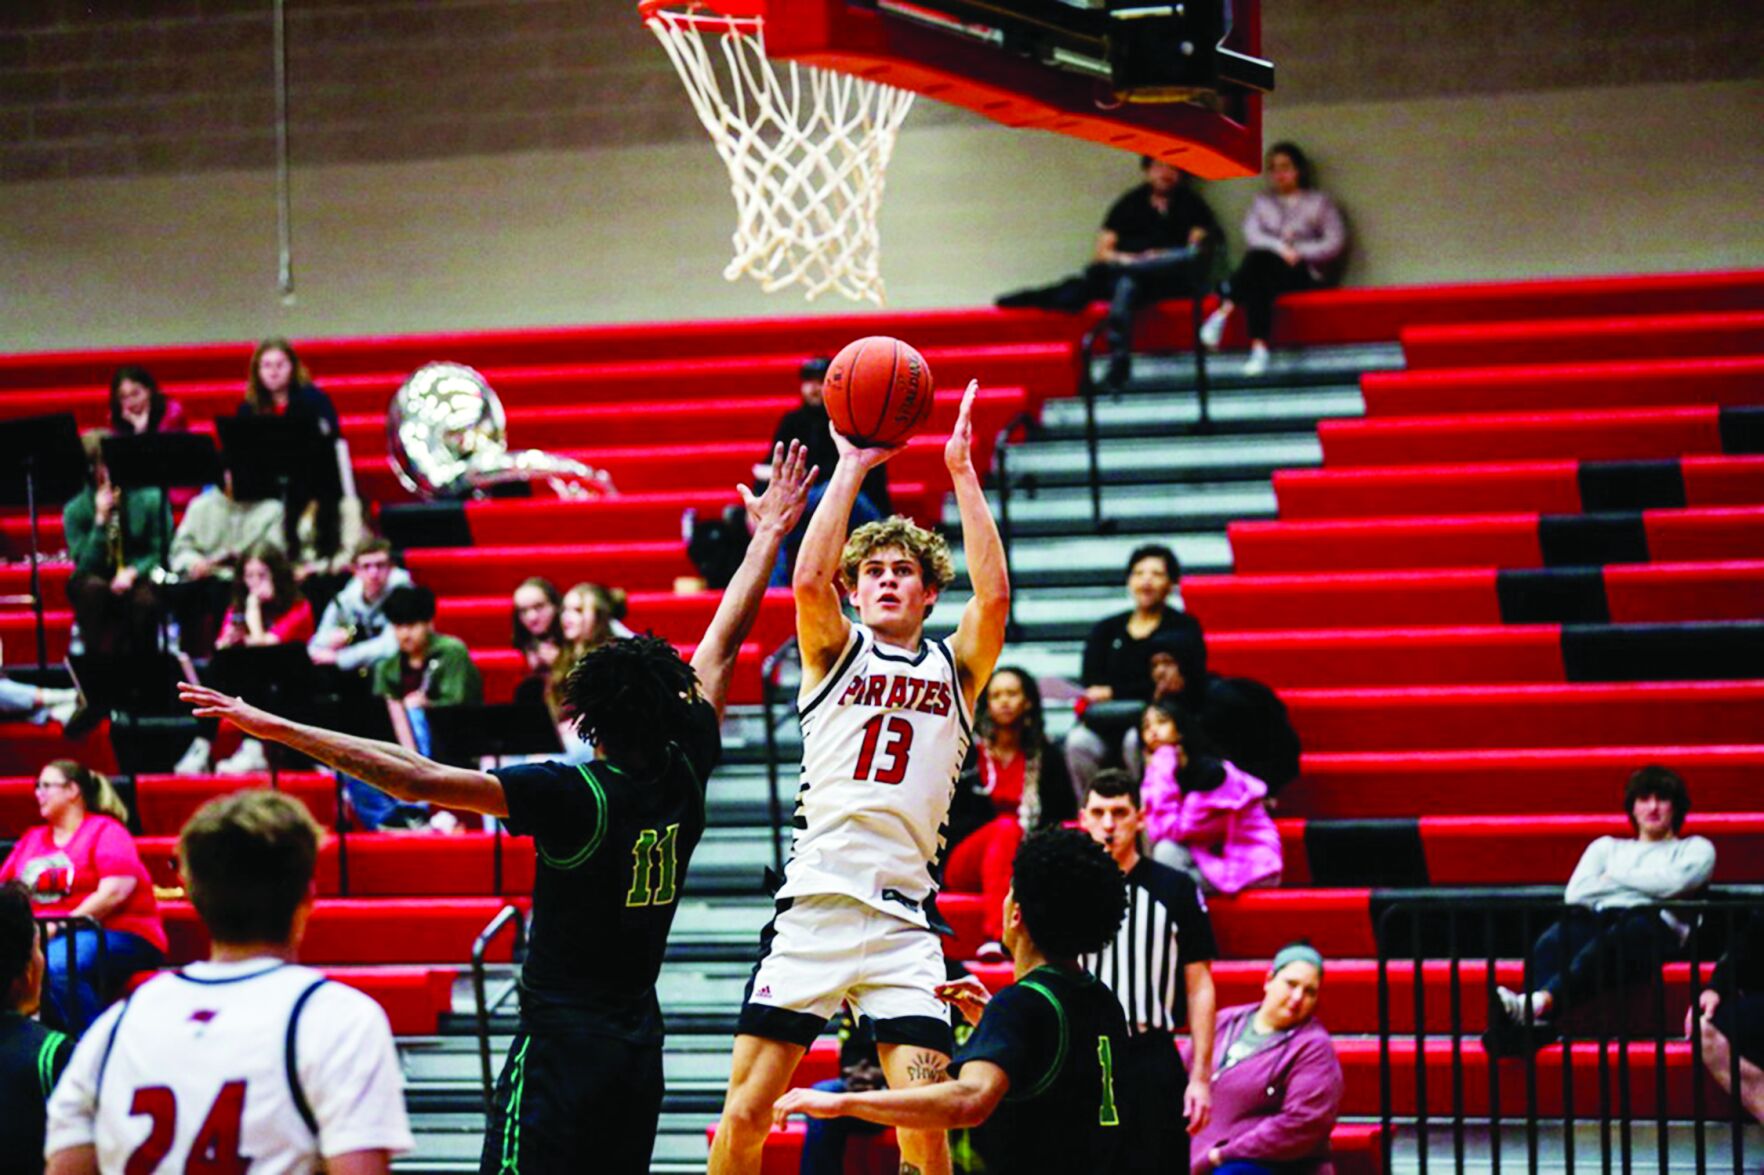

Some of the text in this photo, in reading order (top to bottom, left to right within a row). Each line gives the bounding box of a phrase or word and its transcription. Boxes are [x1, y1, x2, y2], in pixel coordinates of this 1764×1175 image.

[838, 675, 952, 717] PIRATES
[853, 714, 914, 785] 13
[626, 823, 679, 906] 11
[1098, 1035, 1119, 1126] 1
[124, 1080, 252, 1175] 24
